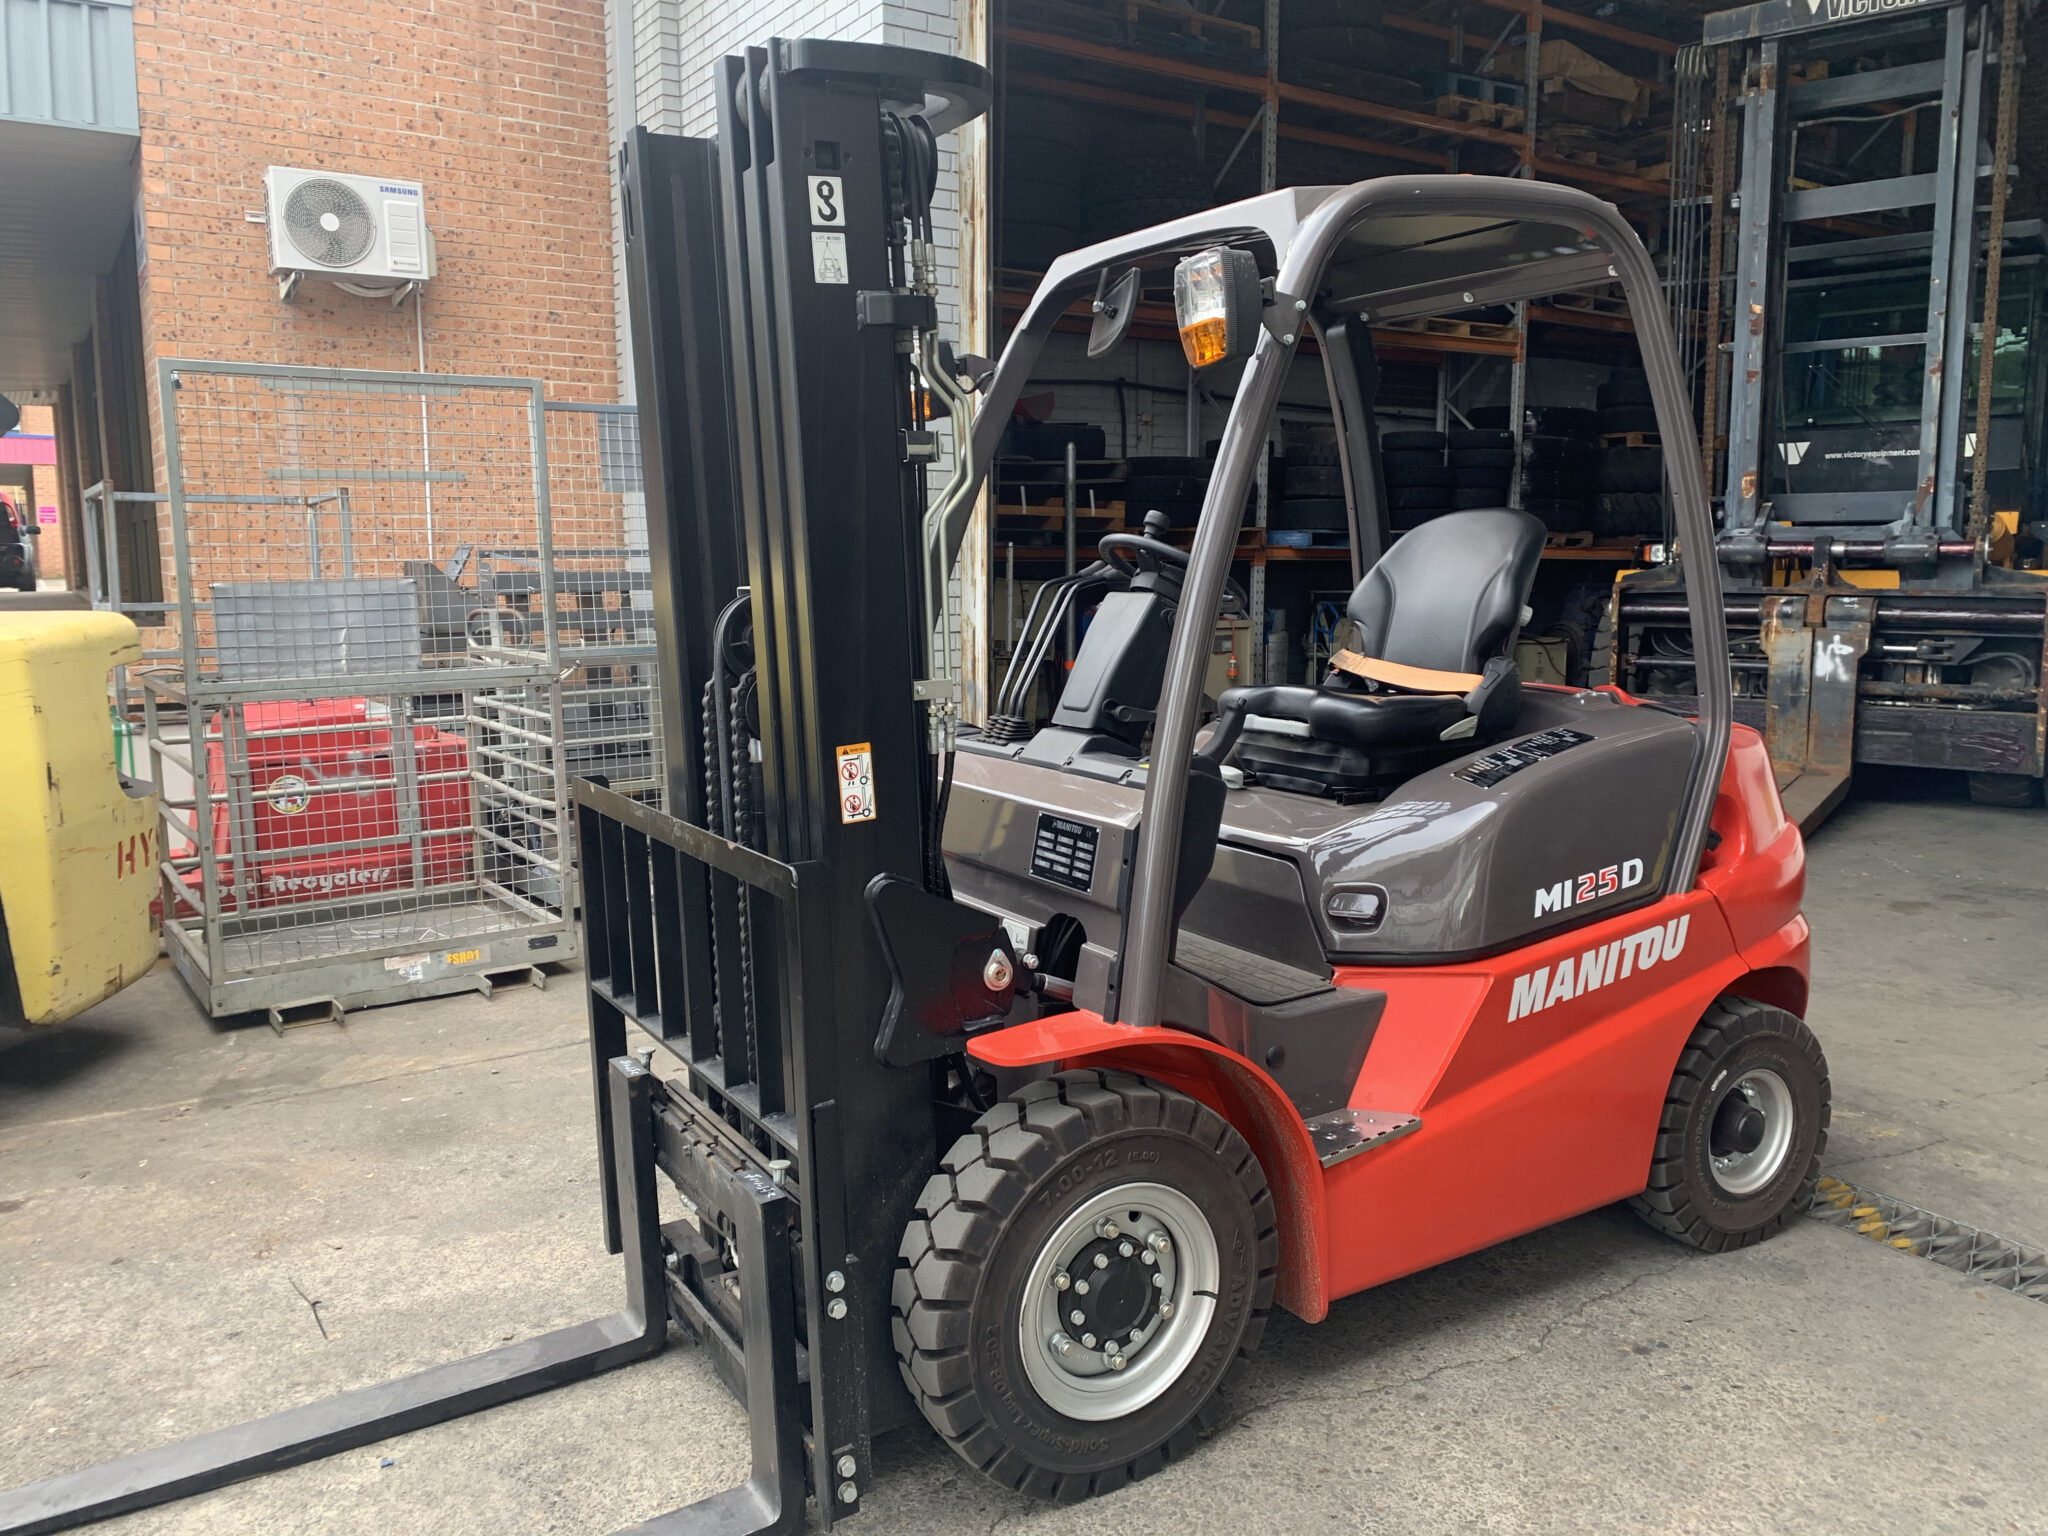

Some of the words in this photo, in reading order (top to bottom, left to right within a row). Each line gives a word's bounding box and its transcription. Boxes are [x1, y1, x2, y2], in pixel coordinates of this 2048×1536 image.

[379, 185, 418, 196] SAMSUNG
[117, 827, 159, 880] HY
[1056, 819, 1083, 835] MANITOU
[1534, 857, 1644, 919] MI25D
[1507, 913, 1691, 1023] MANITOU
[1037, 1148, 1120, 1210] 7.00-12
[1127, 1150, 1161, 1163] (5.00)
[1184, 1272, 1247, 1398] ADVANCE
